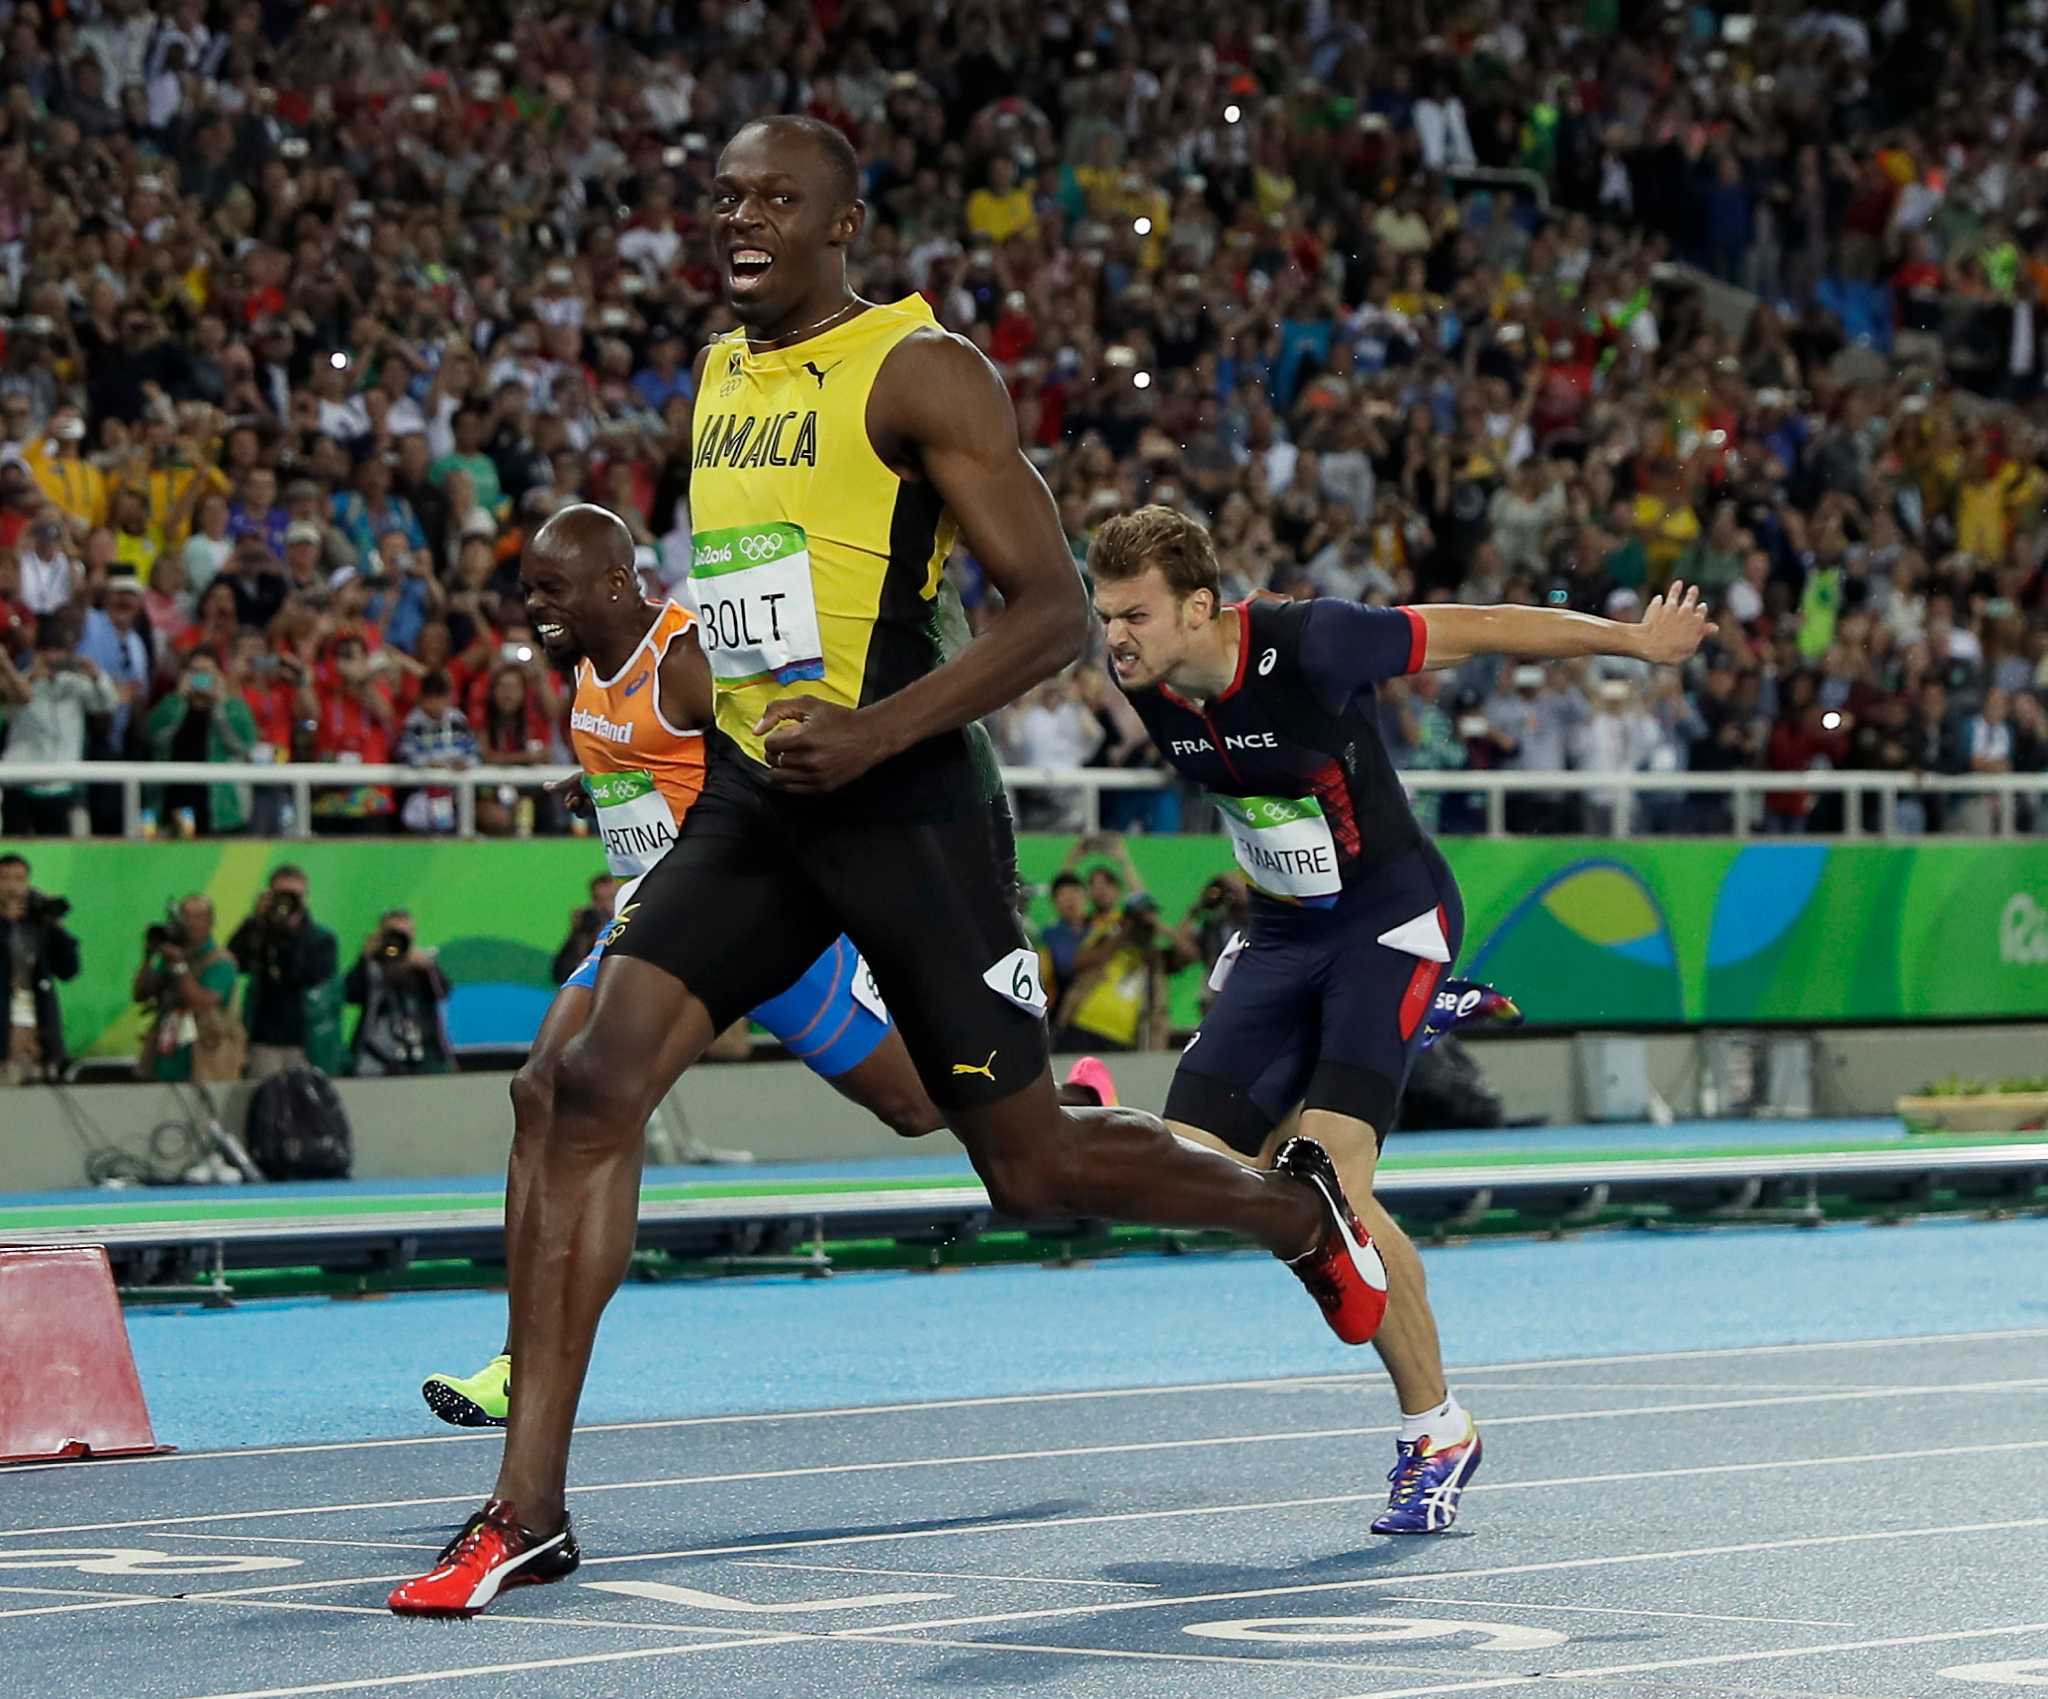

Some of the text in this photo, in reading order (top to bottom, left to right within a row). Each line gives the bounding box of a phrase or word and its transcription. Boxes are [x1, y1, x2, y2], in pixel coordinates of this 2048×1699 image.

[700, 593, 785, 651] BOLT
[1171, 732, 1279, 756] FRANCE
[603, 820, 676, 856] ARTINA
[1239, 839, 1332, 876] MAITRE
[1012, 957, 1033, 1001] 6
